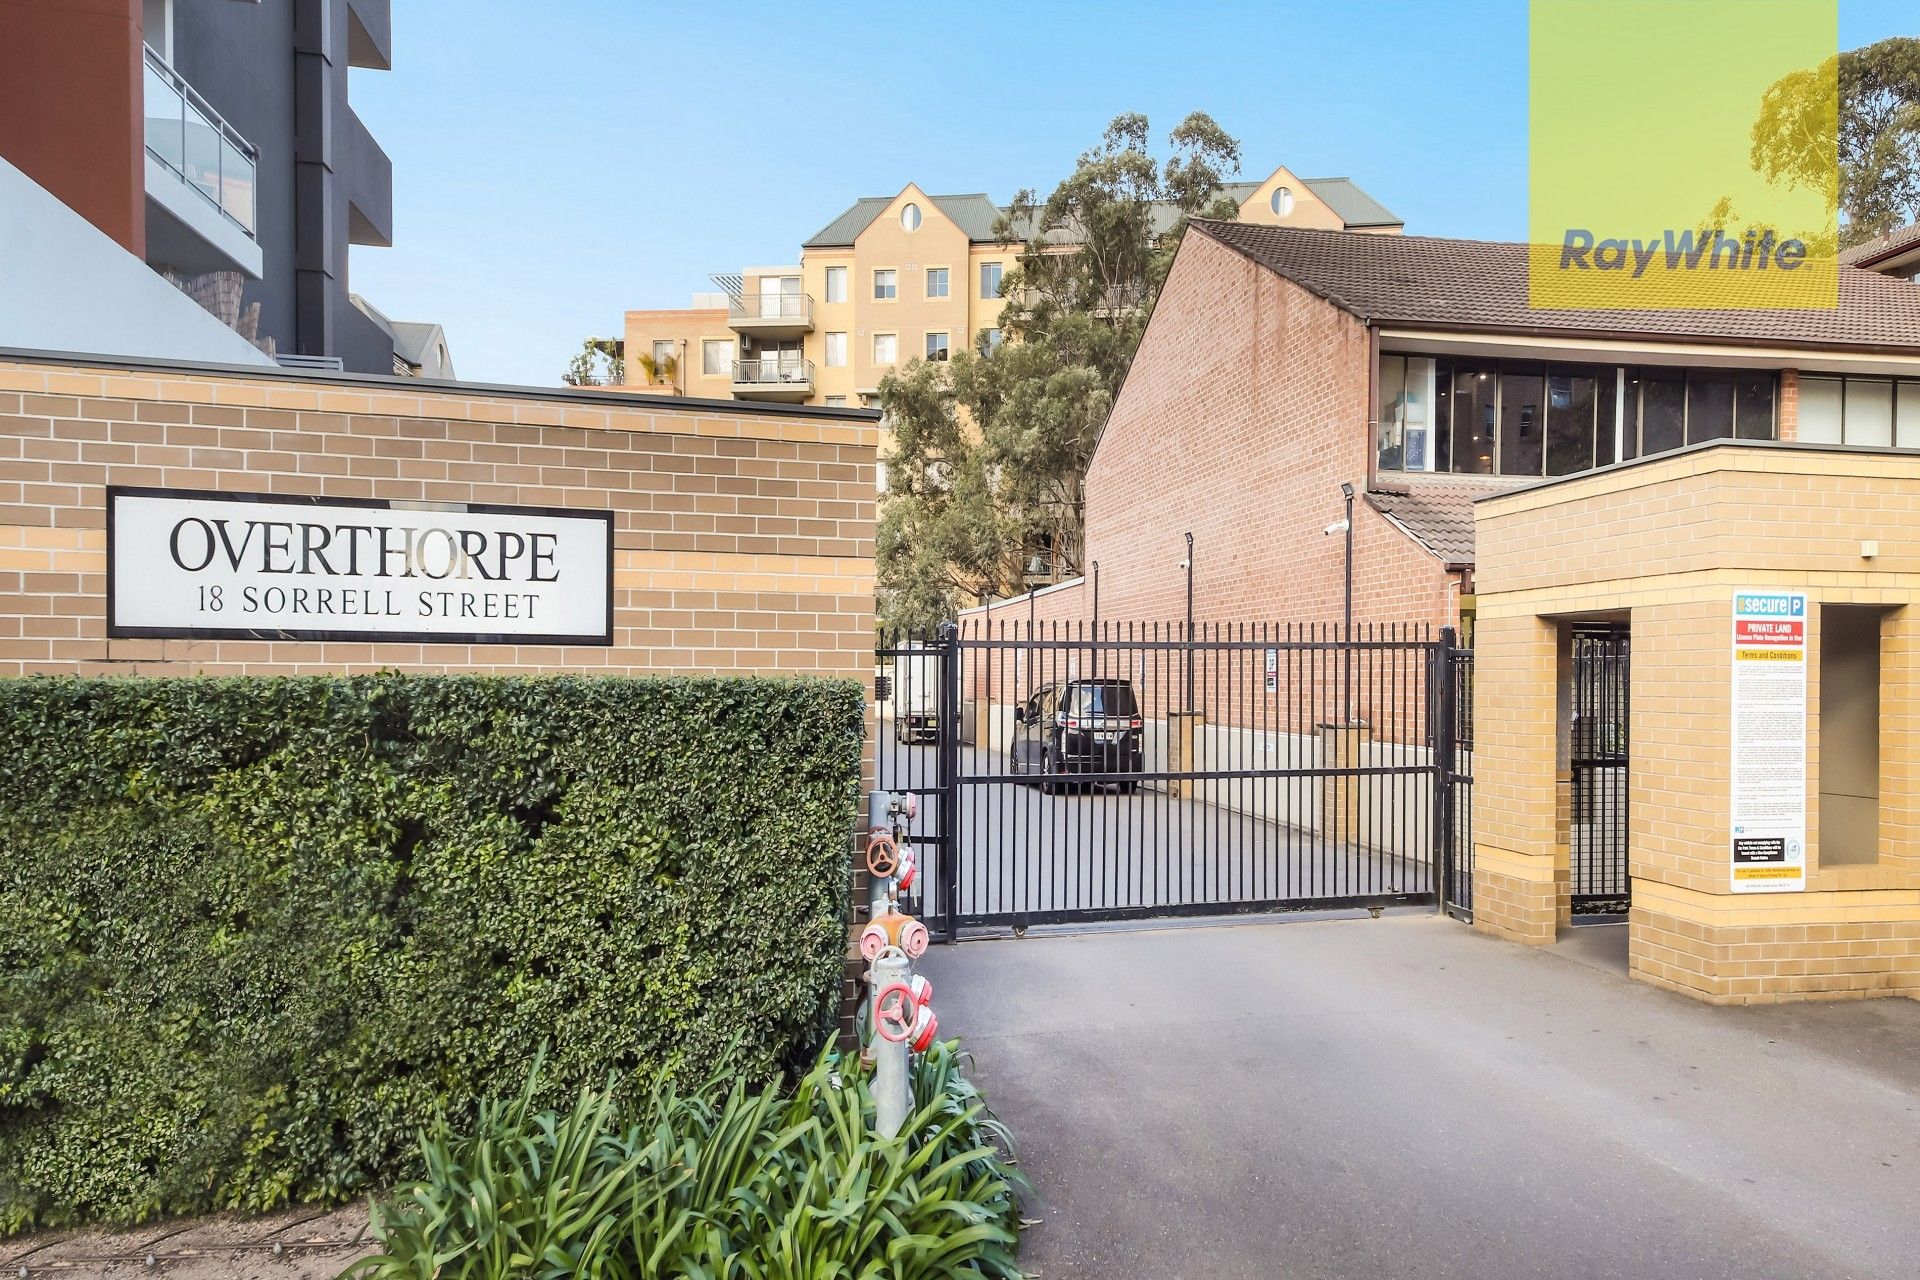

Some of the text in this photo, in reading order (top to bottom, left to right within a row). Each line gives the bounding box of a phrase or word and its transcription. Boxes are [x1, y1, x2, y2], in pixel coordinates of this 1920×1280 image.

[169, 517, 560, 582] OVERTHORPE
[198, 585, 540, 619] 18 SORRELL STREET
[1793, 599, 1801, 613] P
[1748, 624, 1792, 633] PRIVATE LAND
[1742, 651, 1758, 659] Terms
